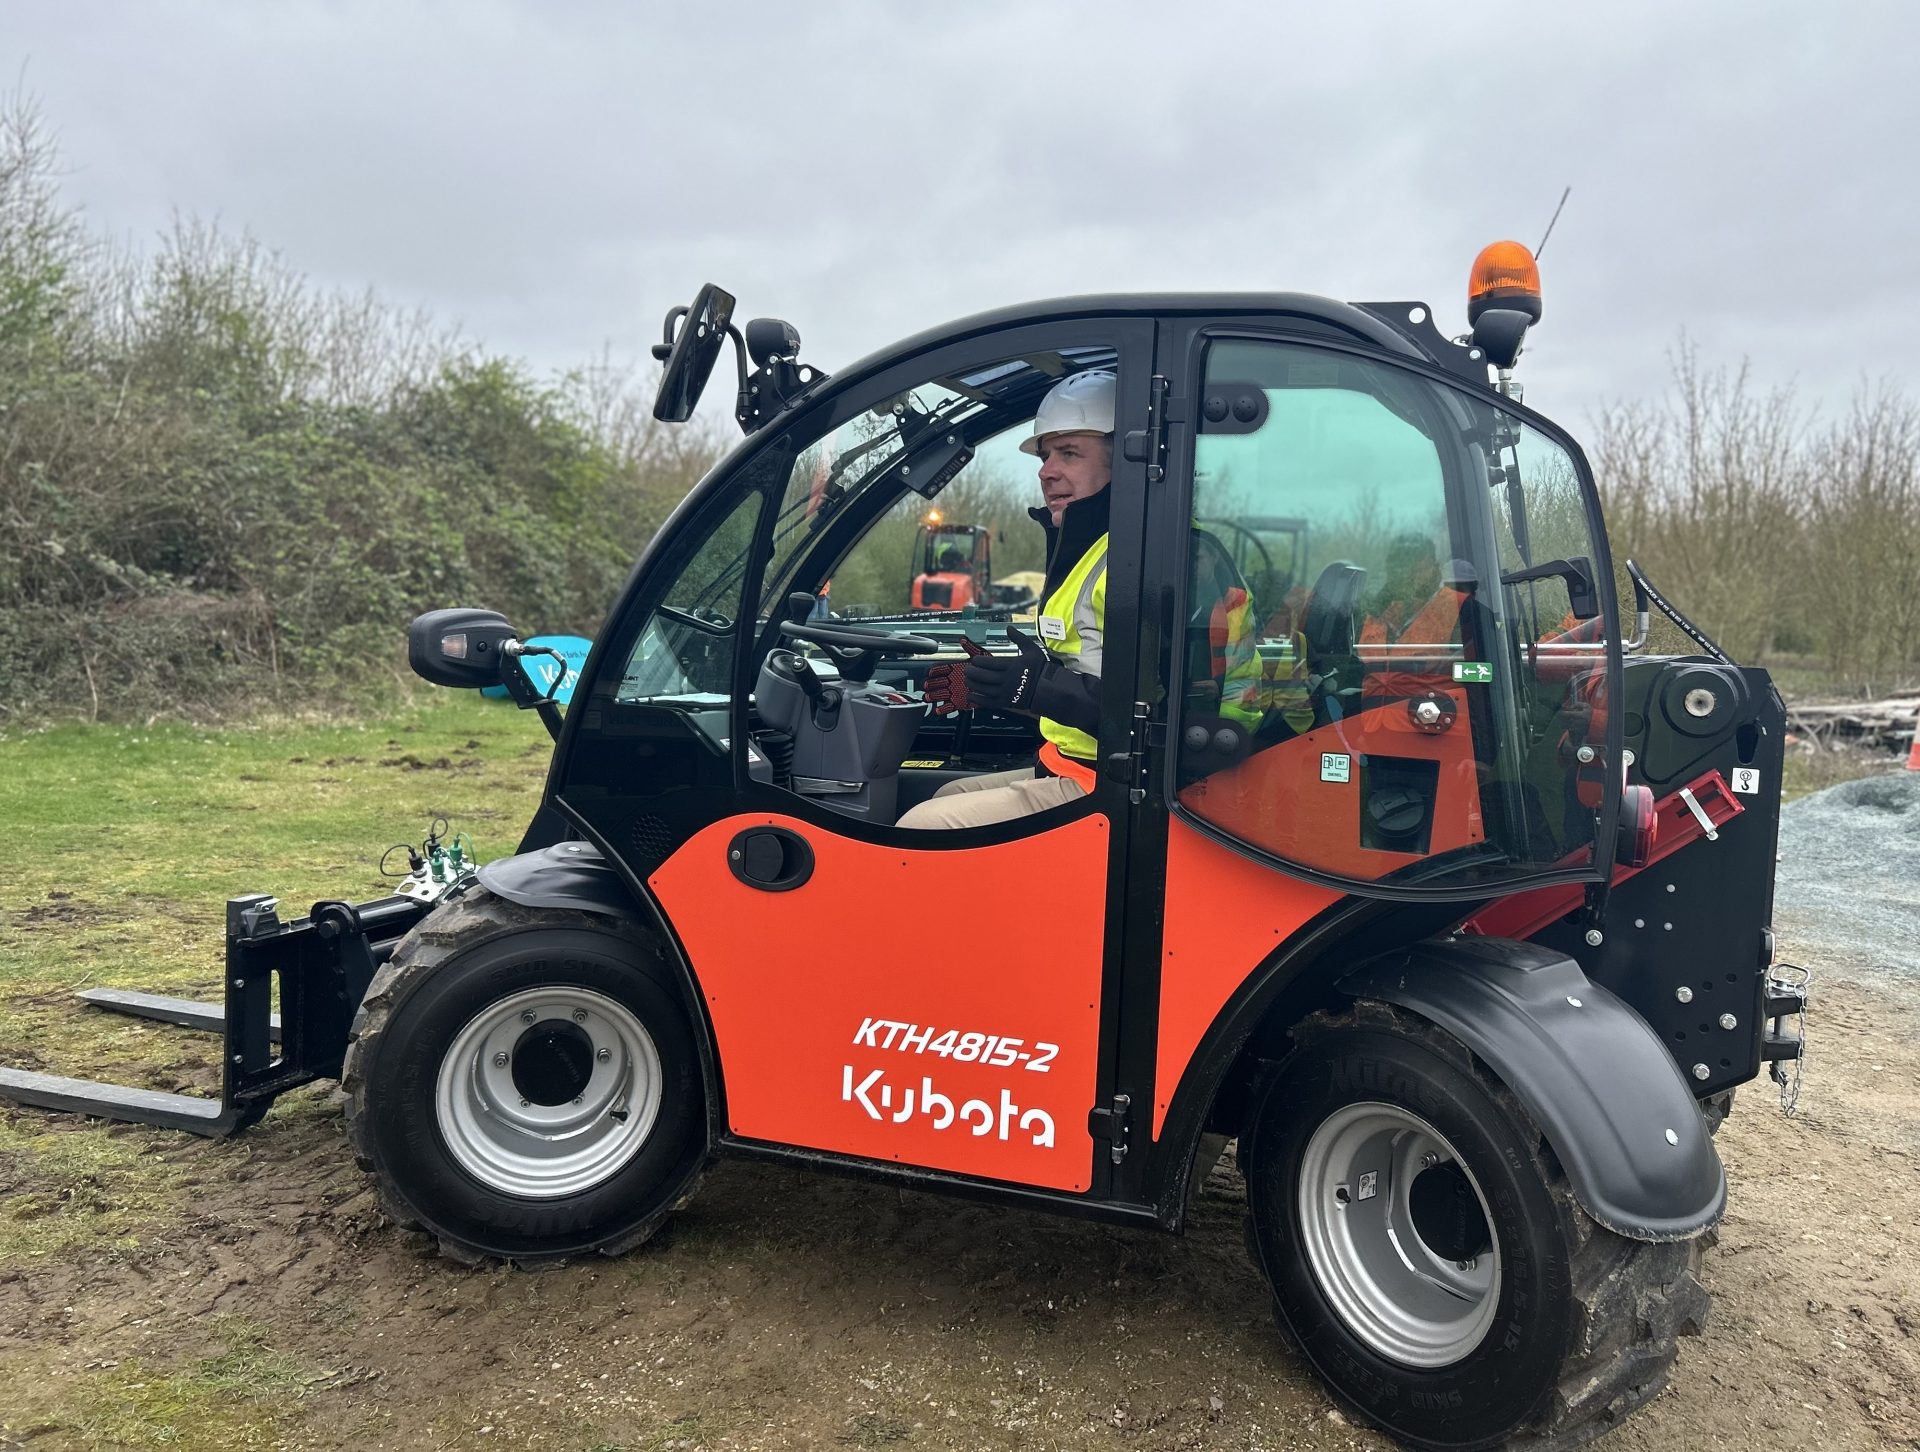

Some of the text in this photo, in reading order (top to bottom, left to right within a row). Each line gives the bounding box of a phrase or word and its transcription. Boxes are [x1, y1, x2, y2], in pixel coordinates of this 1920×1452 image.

[1011, 668, 1029, 704] Kubota
[852, 1017, 1060, 1073] KTH4815-2
[842, 1064, 1055, 1148] Kubota
